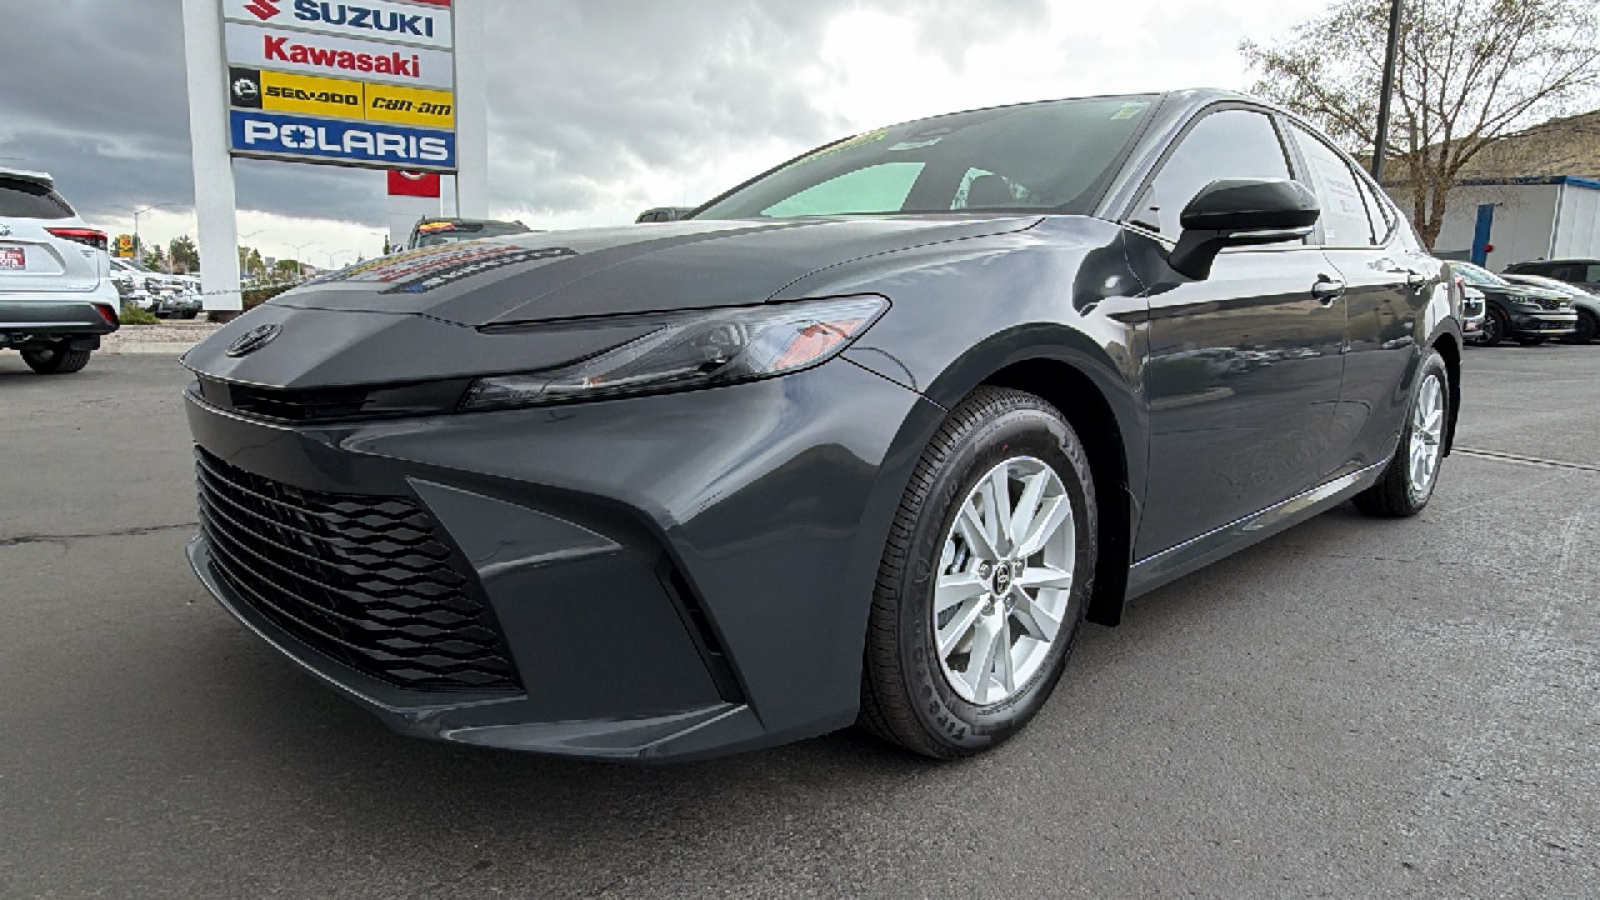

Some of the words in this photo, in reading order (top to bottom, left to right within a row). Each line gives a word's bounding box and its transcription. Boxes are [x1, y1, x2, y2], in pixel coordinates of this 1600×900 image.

[293, 0, 434, 38] SUZUKI
[264, 34, 420, 78] Kawasaki
[371, 96, 452, 116] can-am
[243, 119, 449, 161] POLARIS
